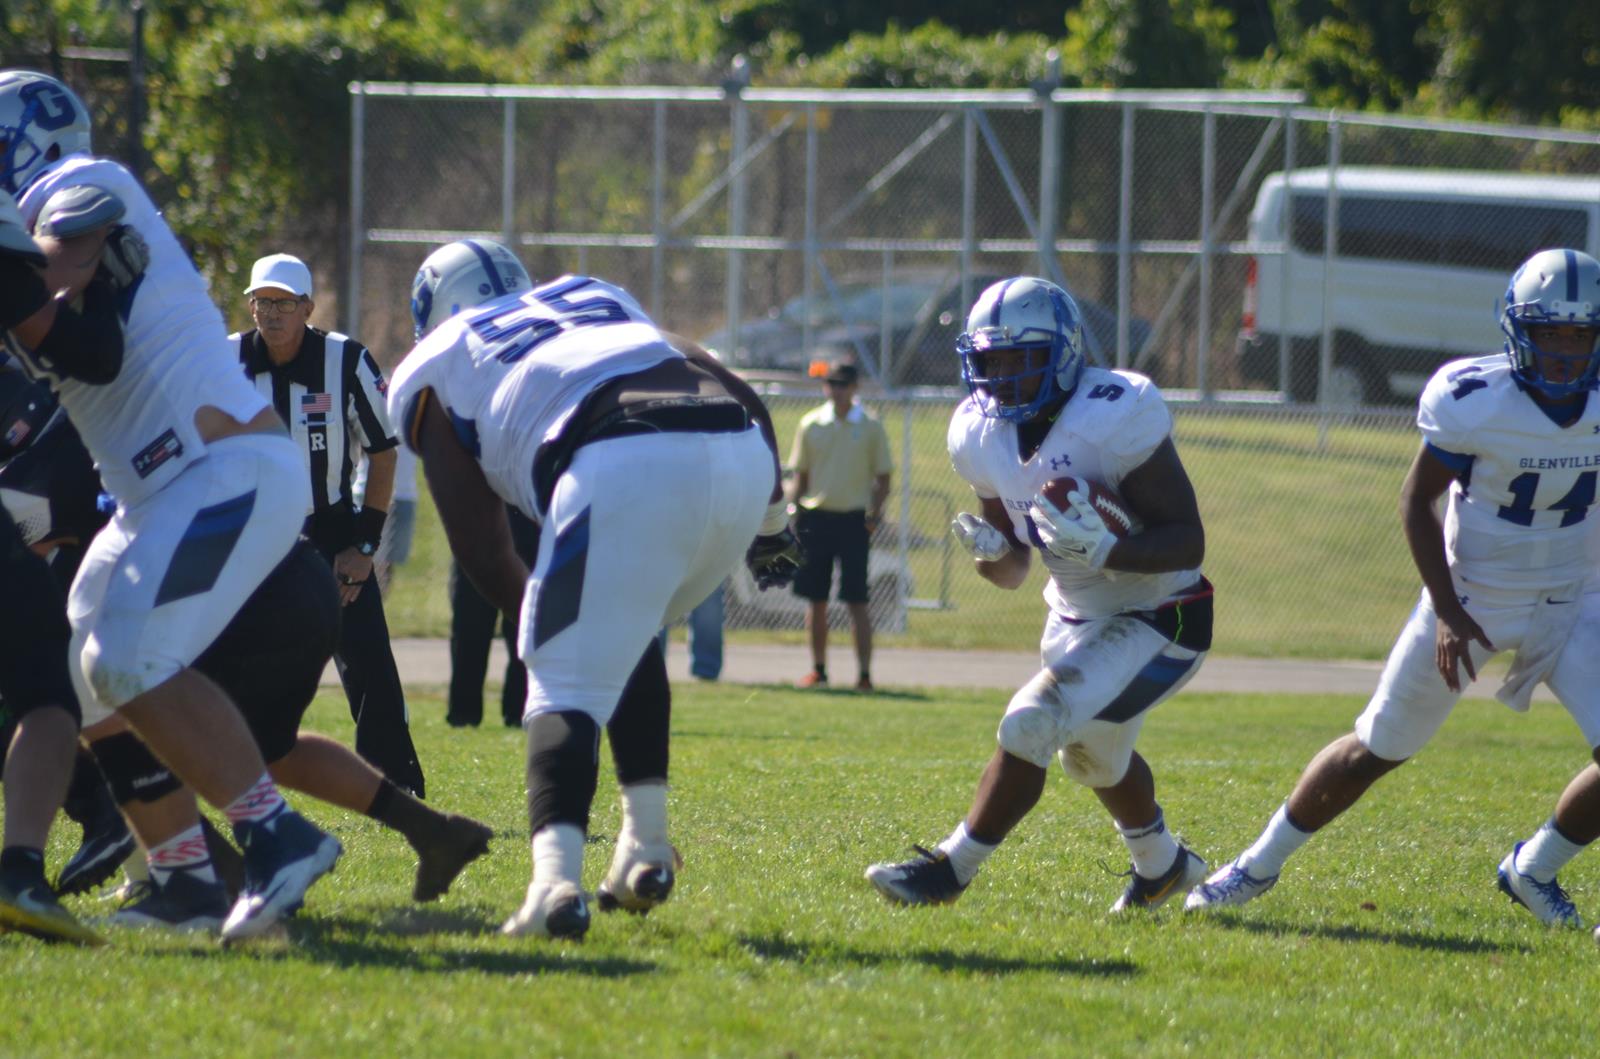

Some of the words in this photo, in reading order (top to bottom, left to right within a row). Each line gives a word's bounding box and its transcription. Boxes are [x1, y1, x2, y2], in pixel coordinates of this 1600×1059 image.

[18, 80, 77, 132] G
[310, 432, 326, 452] R
[1519, 454, 1600, 471] GLENVILLE
[1496, 471, 1599, 528] 14
